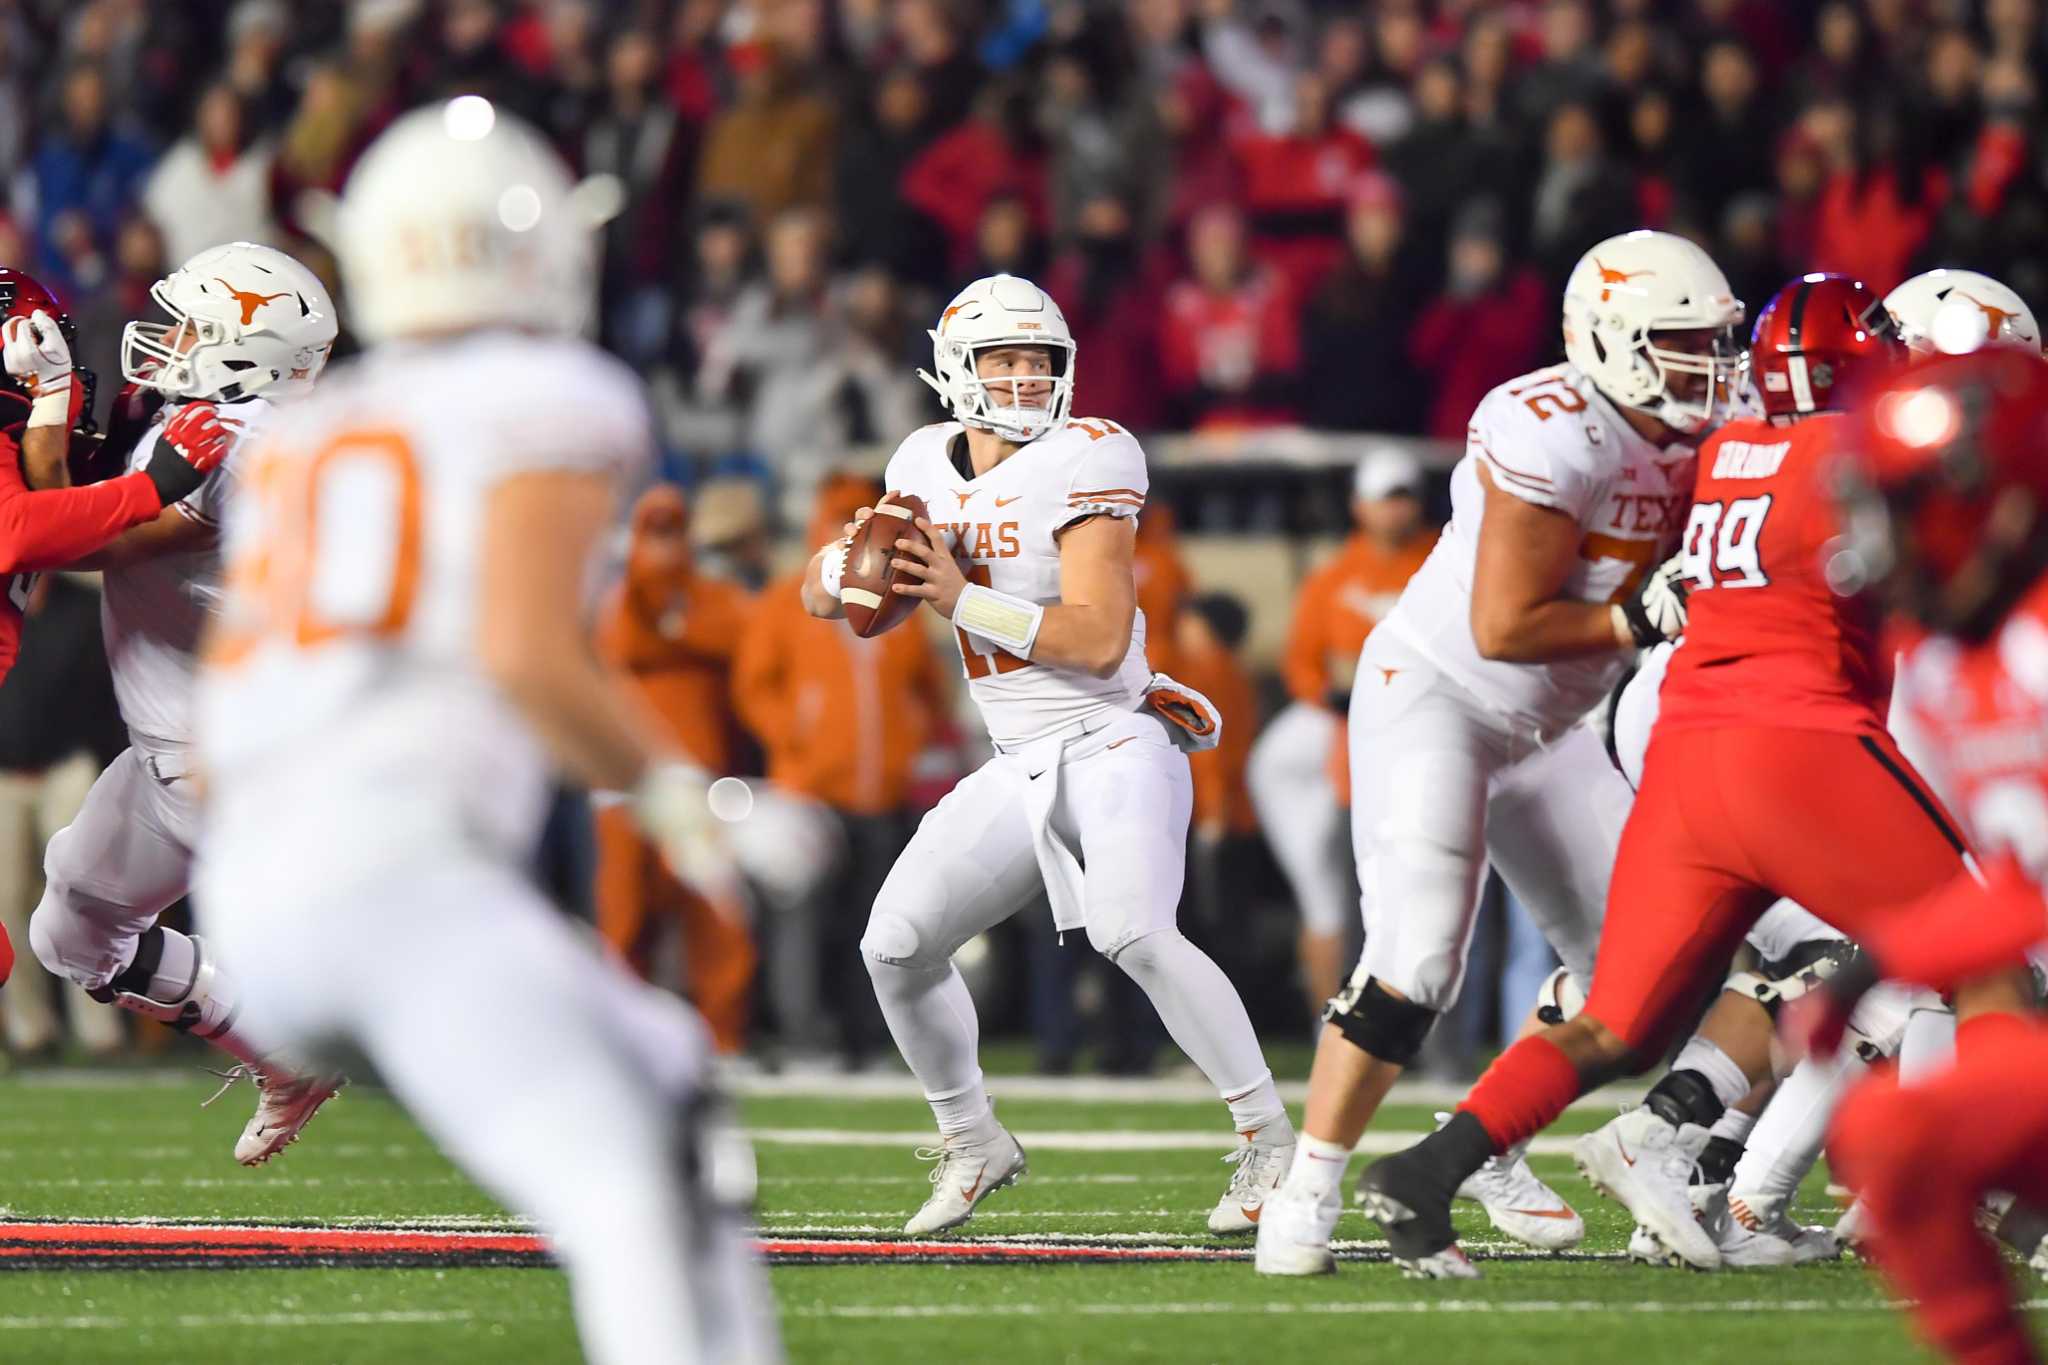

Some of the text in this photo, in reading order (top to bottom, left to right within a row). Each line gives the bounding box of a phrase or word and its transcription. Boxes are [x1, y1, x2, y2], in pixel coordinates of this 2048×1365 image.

[1609, 493, 1681, 532] TEX
[933, 521, 1020, 559] XAS
[1681, 492, 1773, 590] 99
